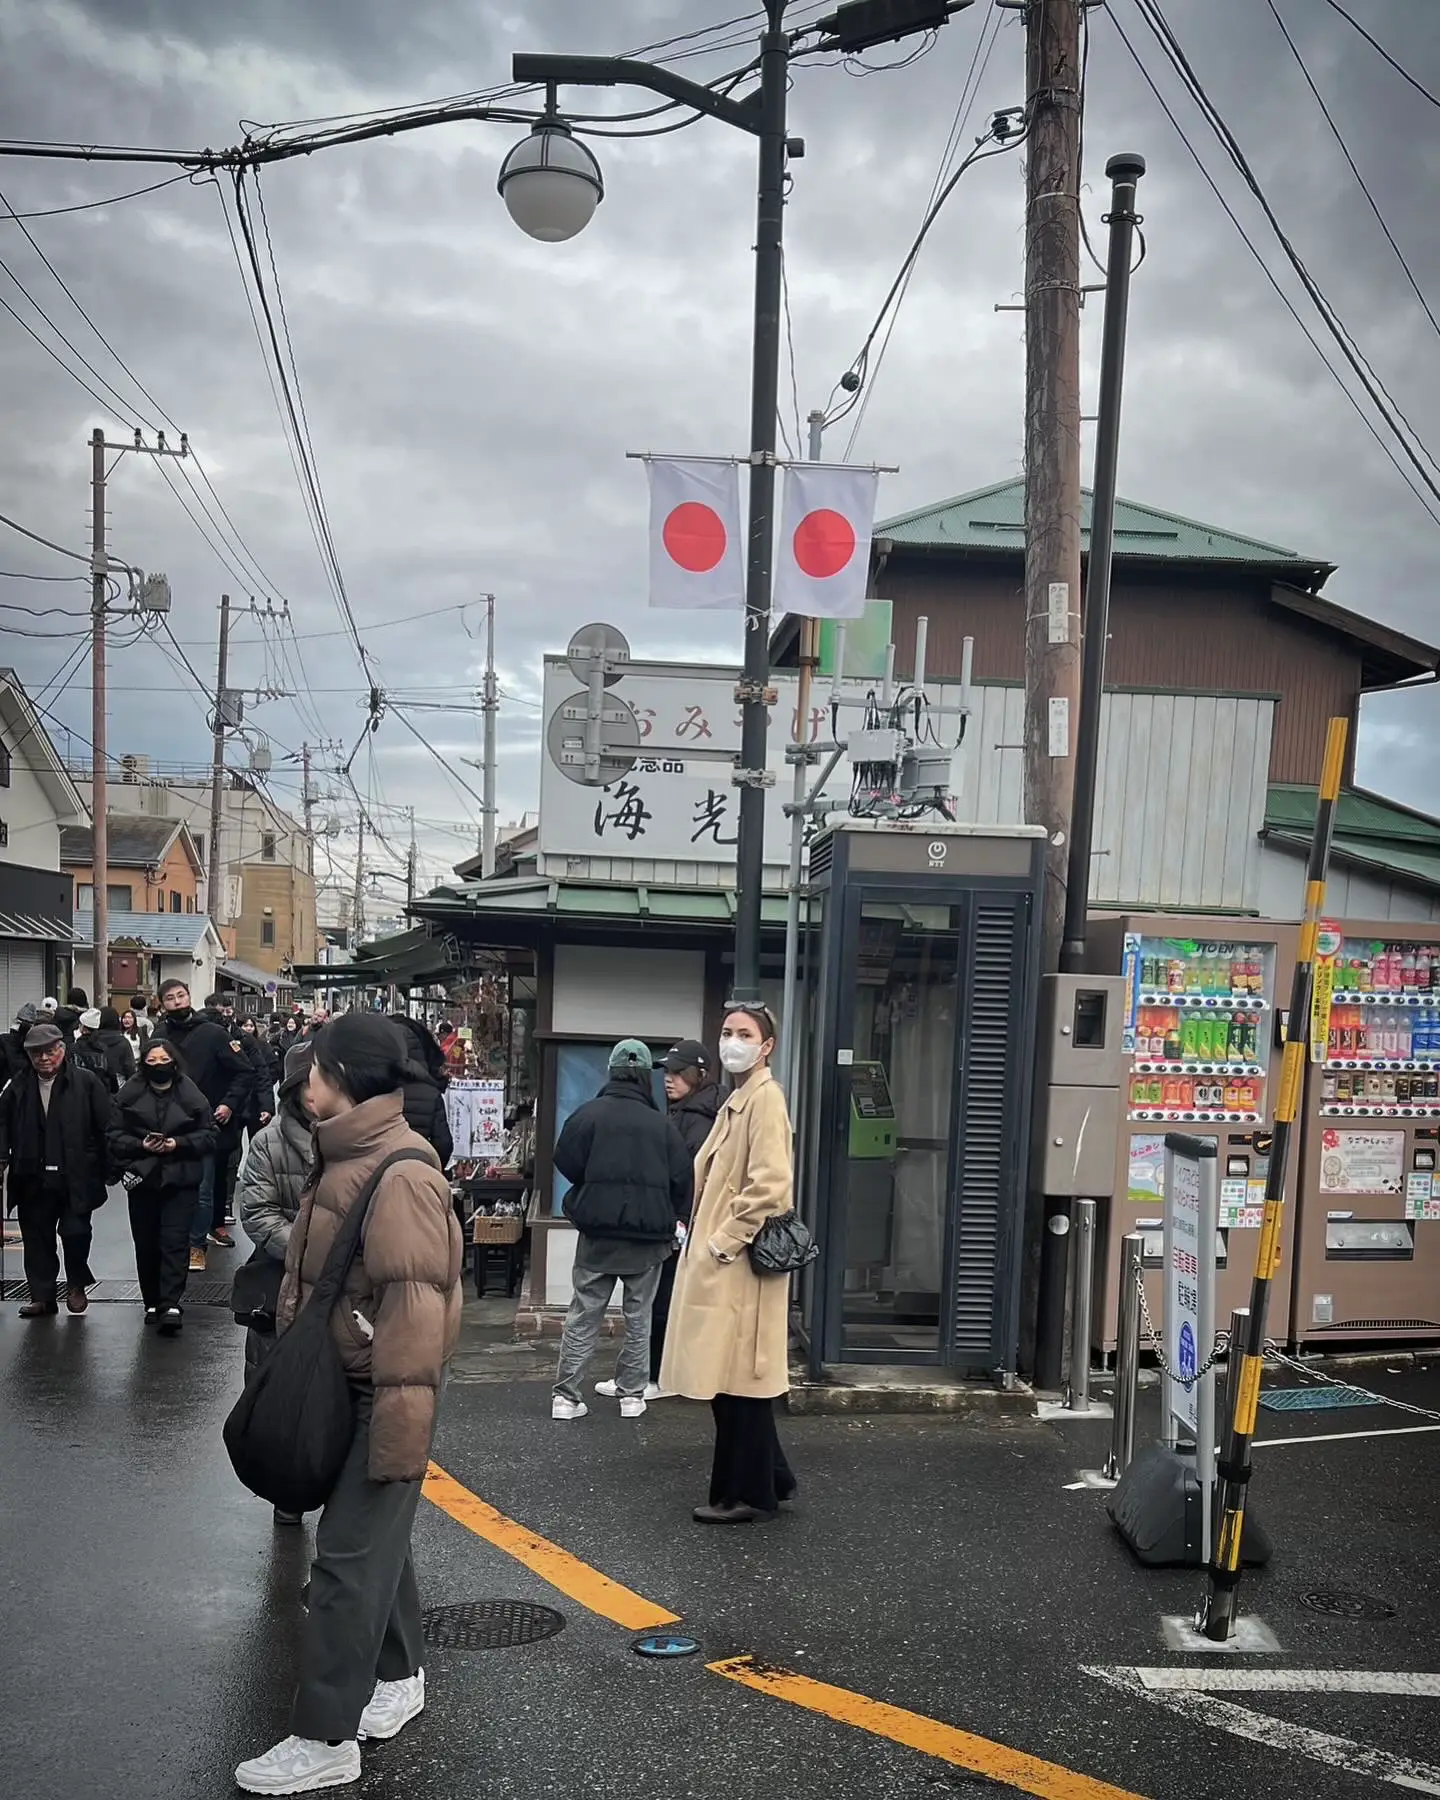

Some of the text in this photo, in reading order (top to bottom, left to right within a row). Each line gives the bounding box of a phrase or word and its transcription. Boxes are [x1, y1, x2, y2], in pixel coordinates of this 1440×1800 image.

[928, 860, 944, 868] NTT
[1196, 943, 1234, 953] ITO EN
